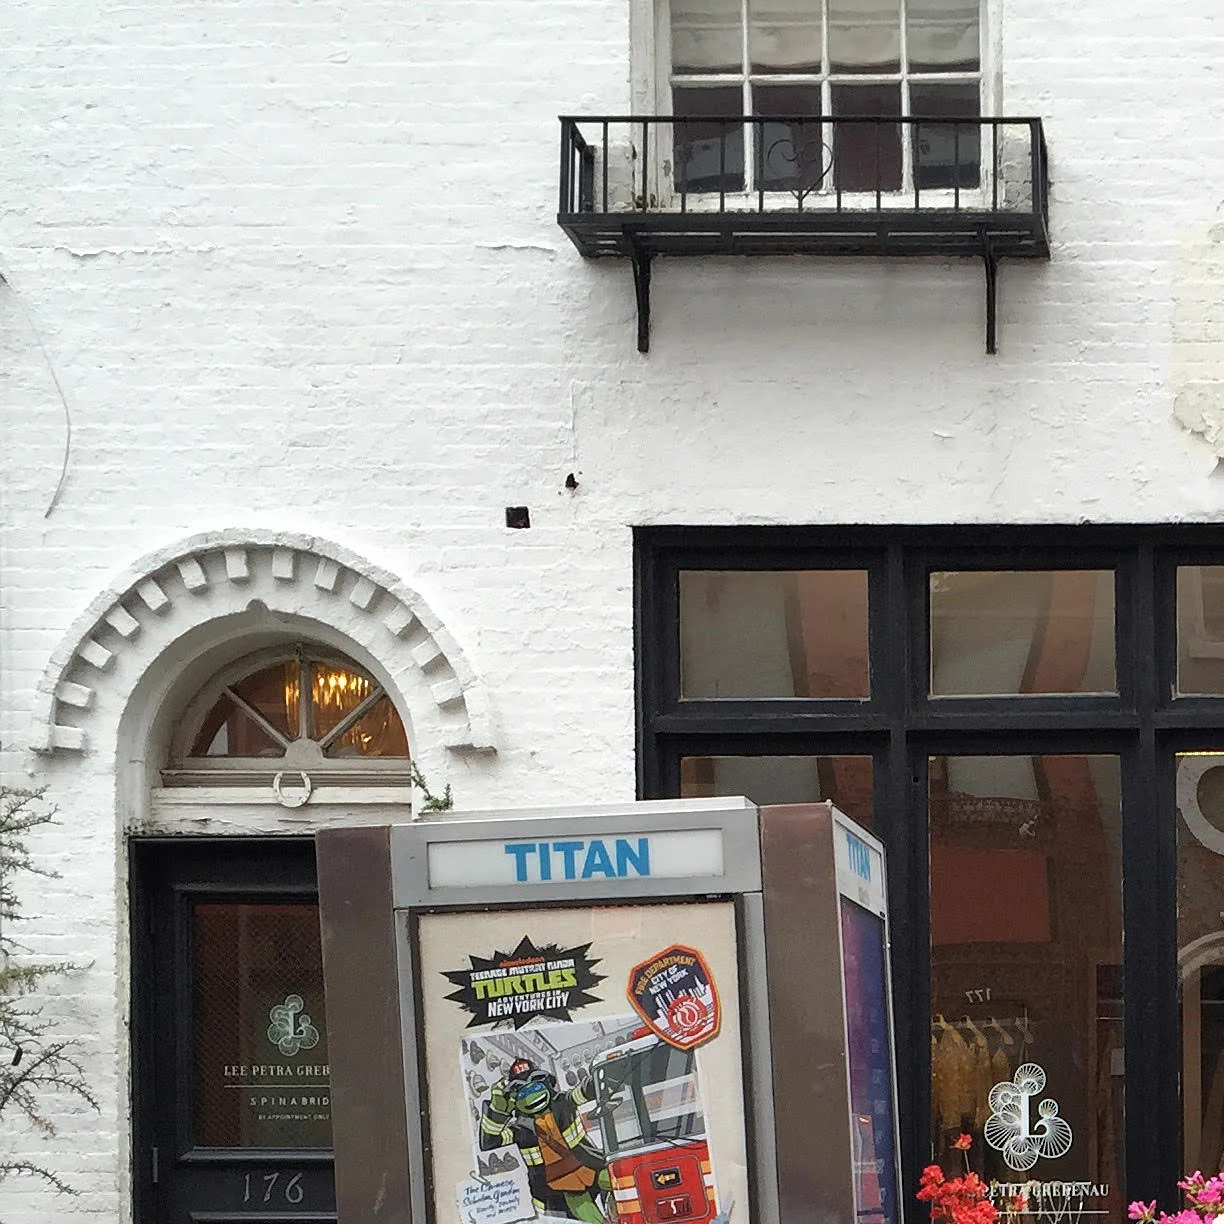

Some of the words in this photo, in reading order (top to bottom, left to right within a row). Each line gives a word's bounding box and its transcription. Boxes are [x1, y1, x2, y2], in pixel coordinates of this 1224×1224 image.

[505, 837, 650, 882] TITAN
[846, 832, 871, 882] TITAN
[644, 955, 697, 978] DEPARTMENT
[650, 970, 668, 985] CITY
[471, 968, 578, 1000] TURTLES
[648, 979, 668, 995] NEW
[667, 968, 689, 984] YORK
[488, 1001, 513, 1018] NEW
[514, 996, 545, 1014] YORK
[546, 991, 570, 1009] CITY
[224, 1065, 248, 1076] LEE
[252, 1065, 293, 1076] PETRA
[296, 1065, 330, 1076] GREB
[301, 1096, 330, 1106] BRID
[243, 1172, 304, 1204] 176
